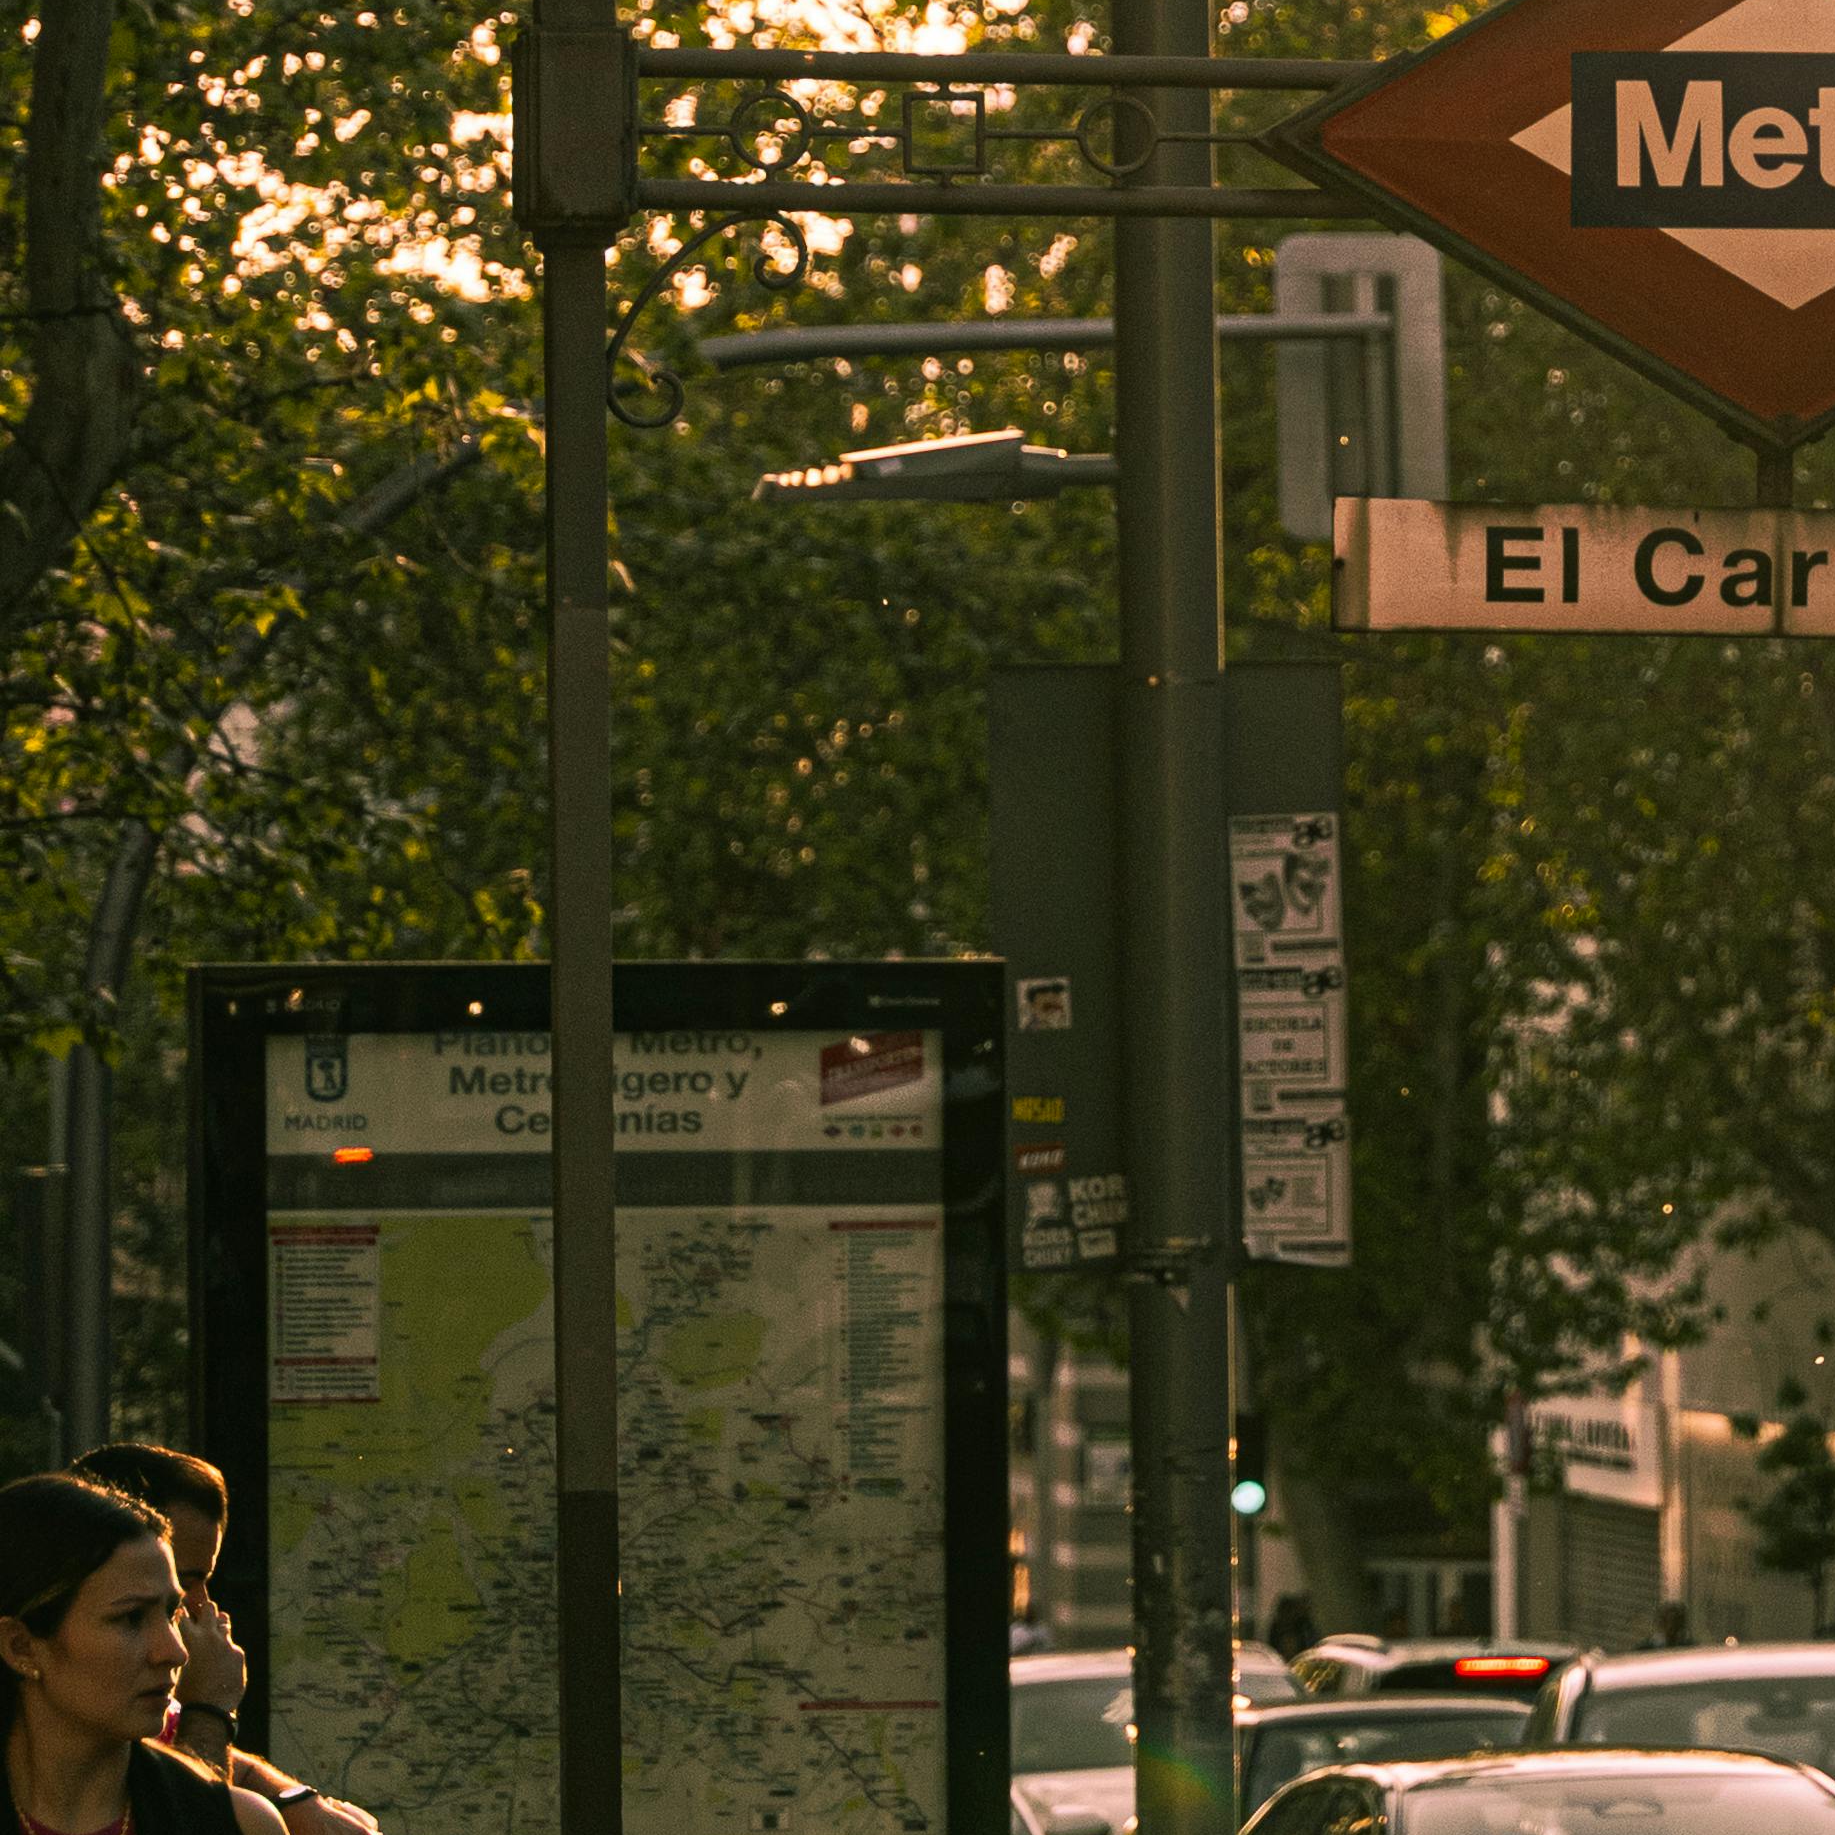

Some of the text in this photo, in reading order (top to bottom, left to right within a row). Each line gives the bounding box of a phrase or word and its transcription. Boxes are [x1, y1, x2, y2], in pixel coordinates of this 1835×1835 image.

[1484, 525, 1580, 604] El
[450, 1067, 551, 1095] Metr
[725, 1071, 749, 1099] y
[284, 1115, 368, 1131] MADRID
